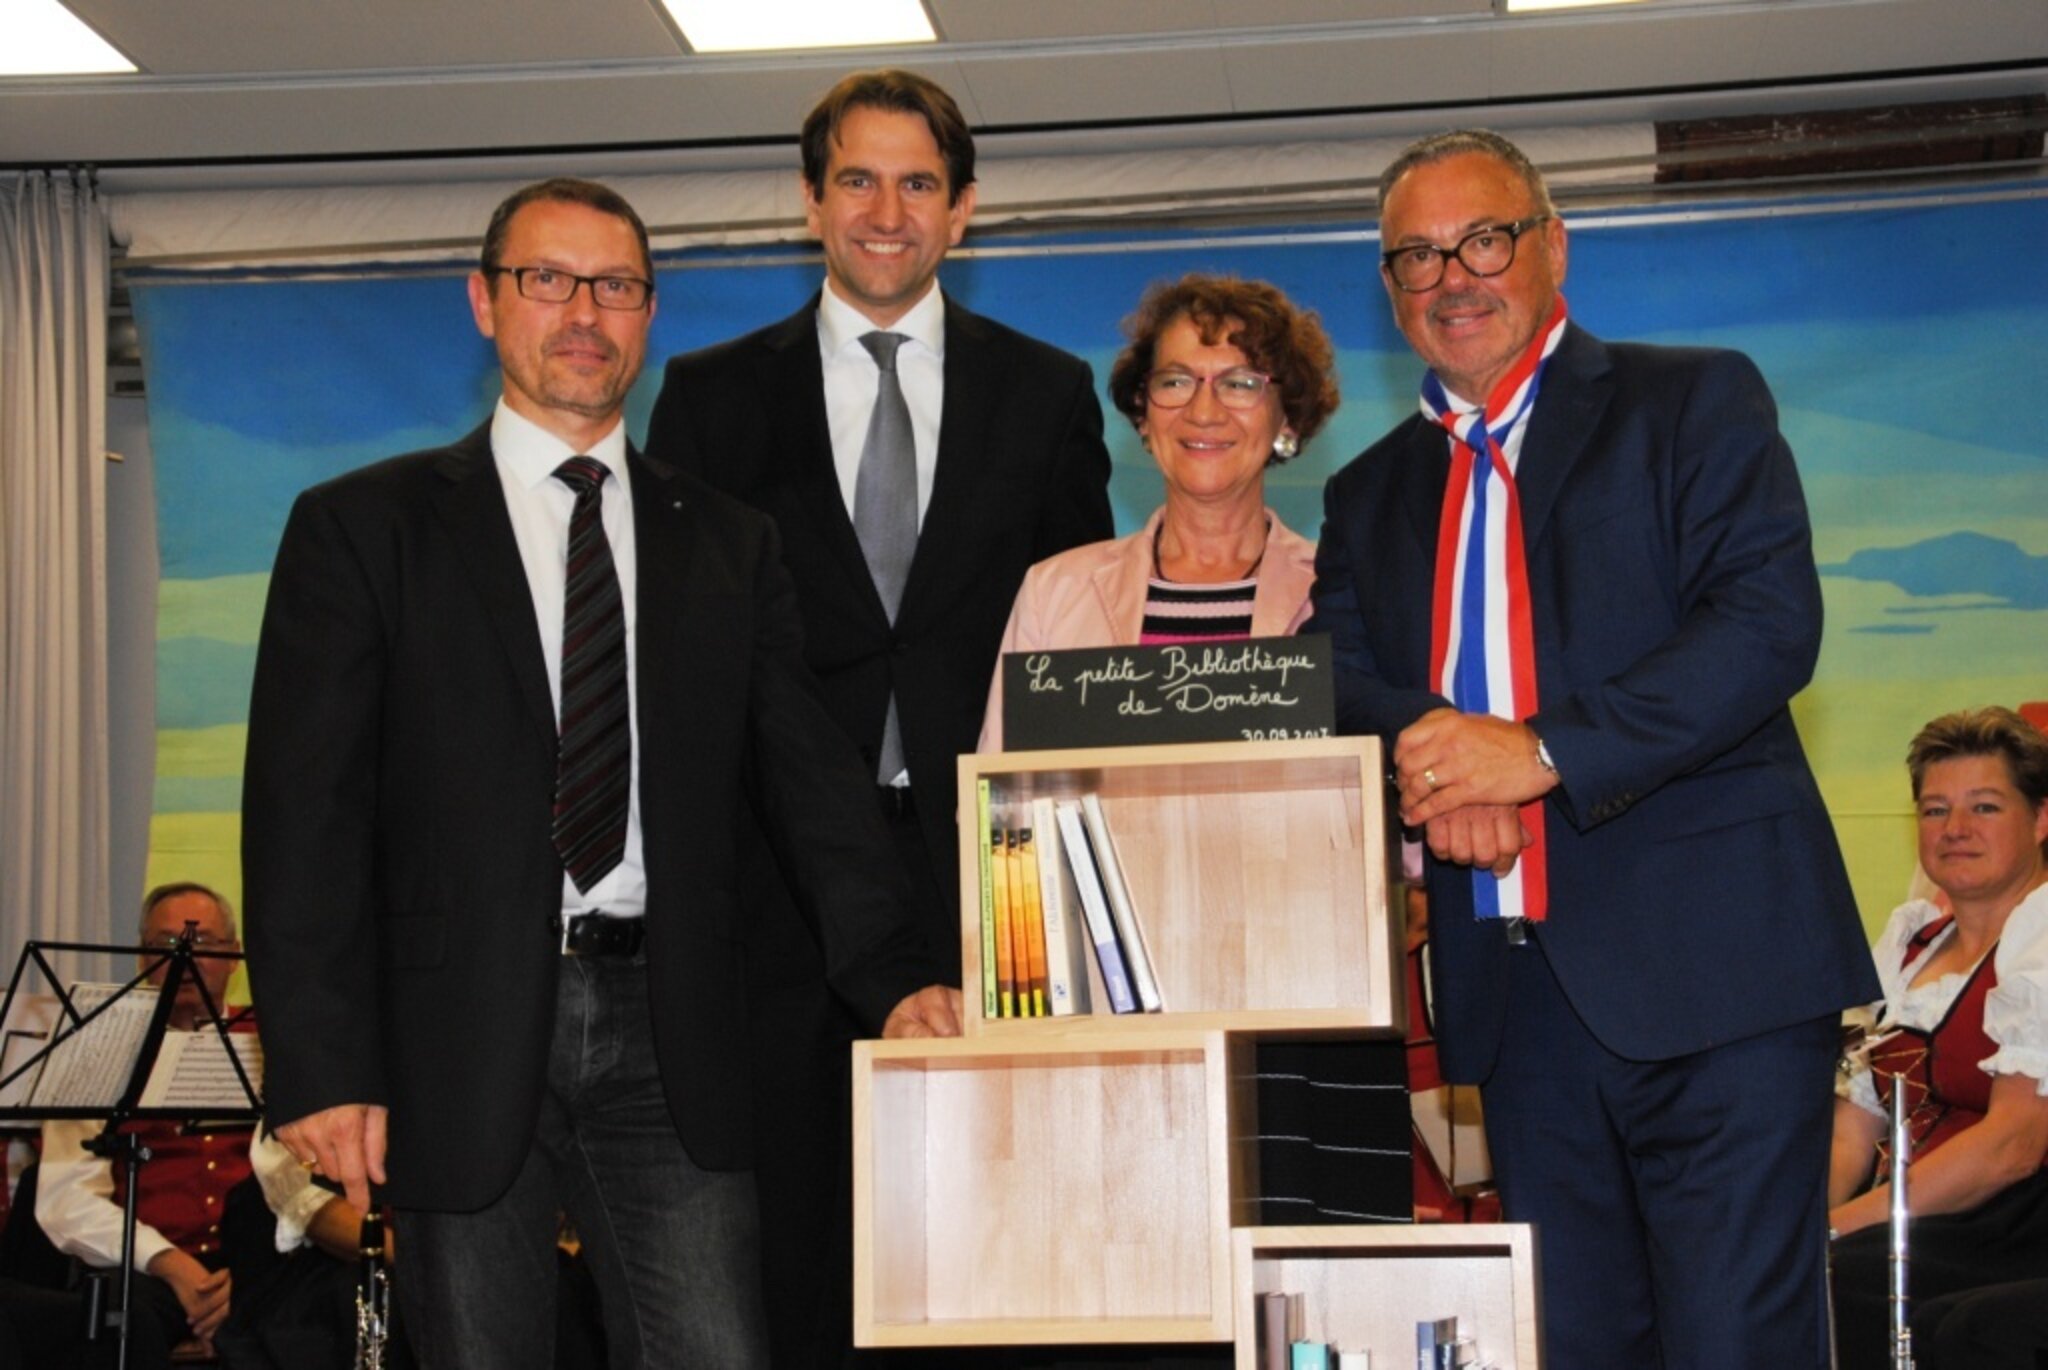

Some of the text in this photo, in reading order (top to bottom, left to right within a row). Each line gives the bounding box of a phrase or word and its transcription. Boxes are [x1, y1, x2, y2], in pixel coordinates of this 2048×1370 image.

[1026, 646, 1316, 705] La petite Bibliothèque
[1118, 684, 1299, 715] de Domène
